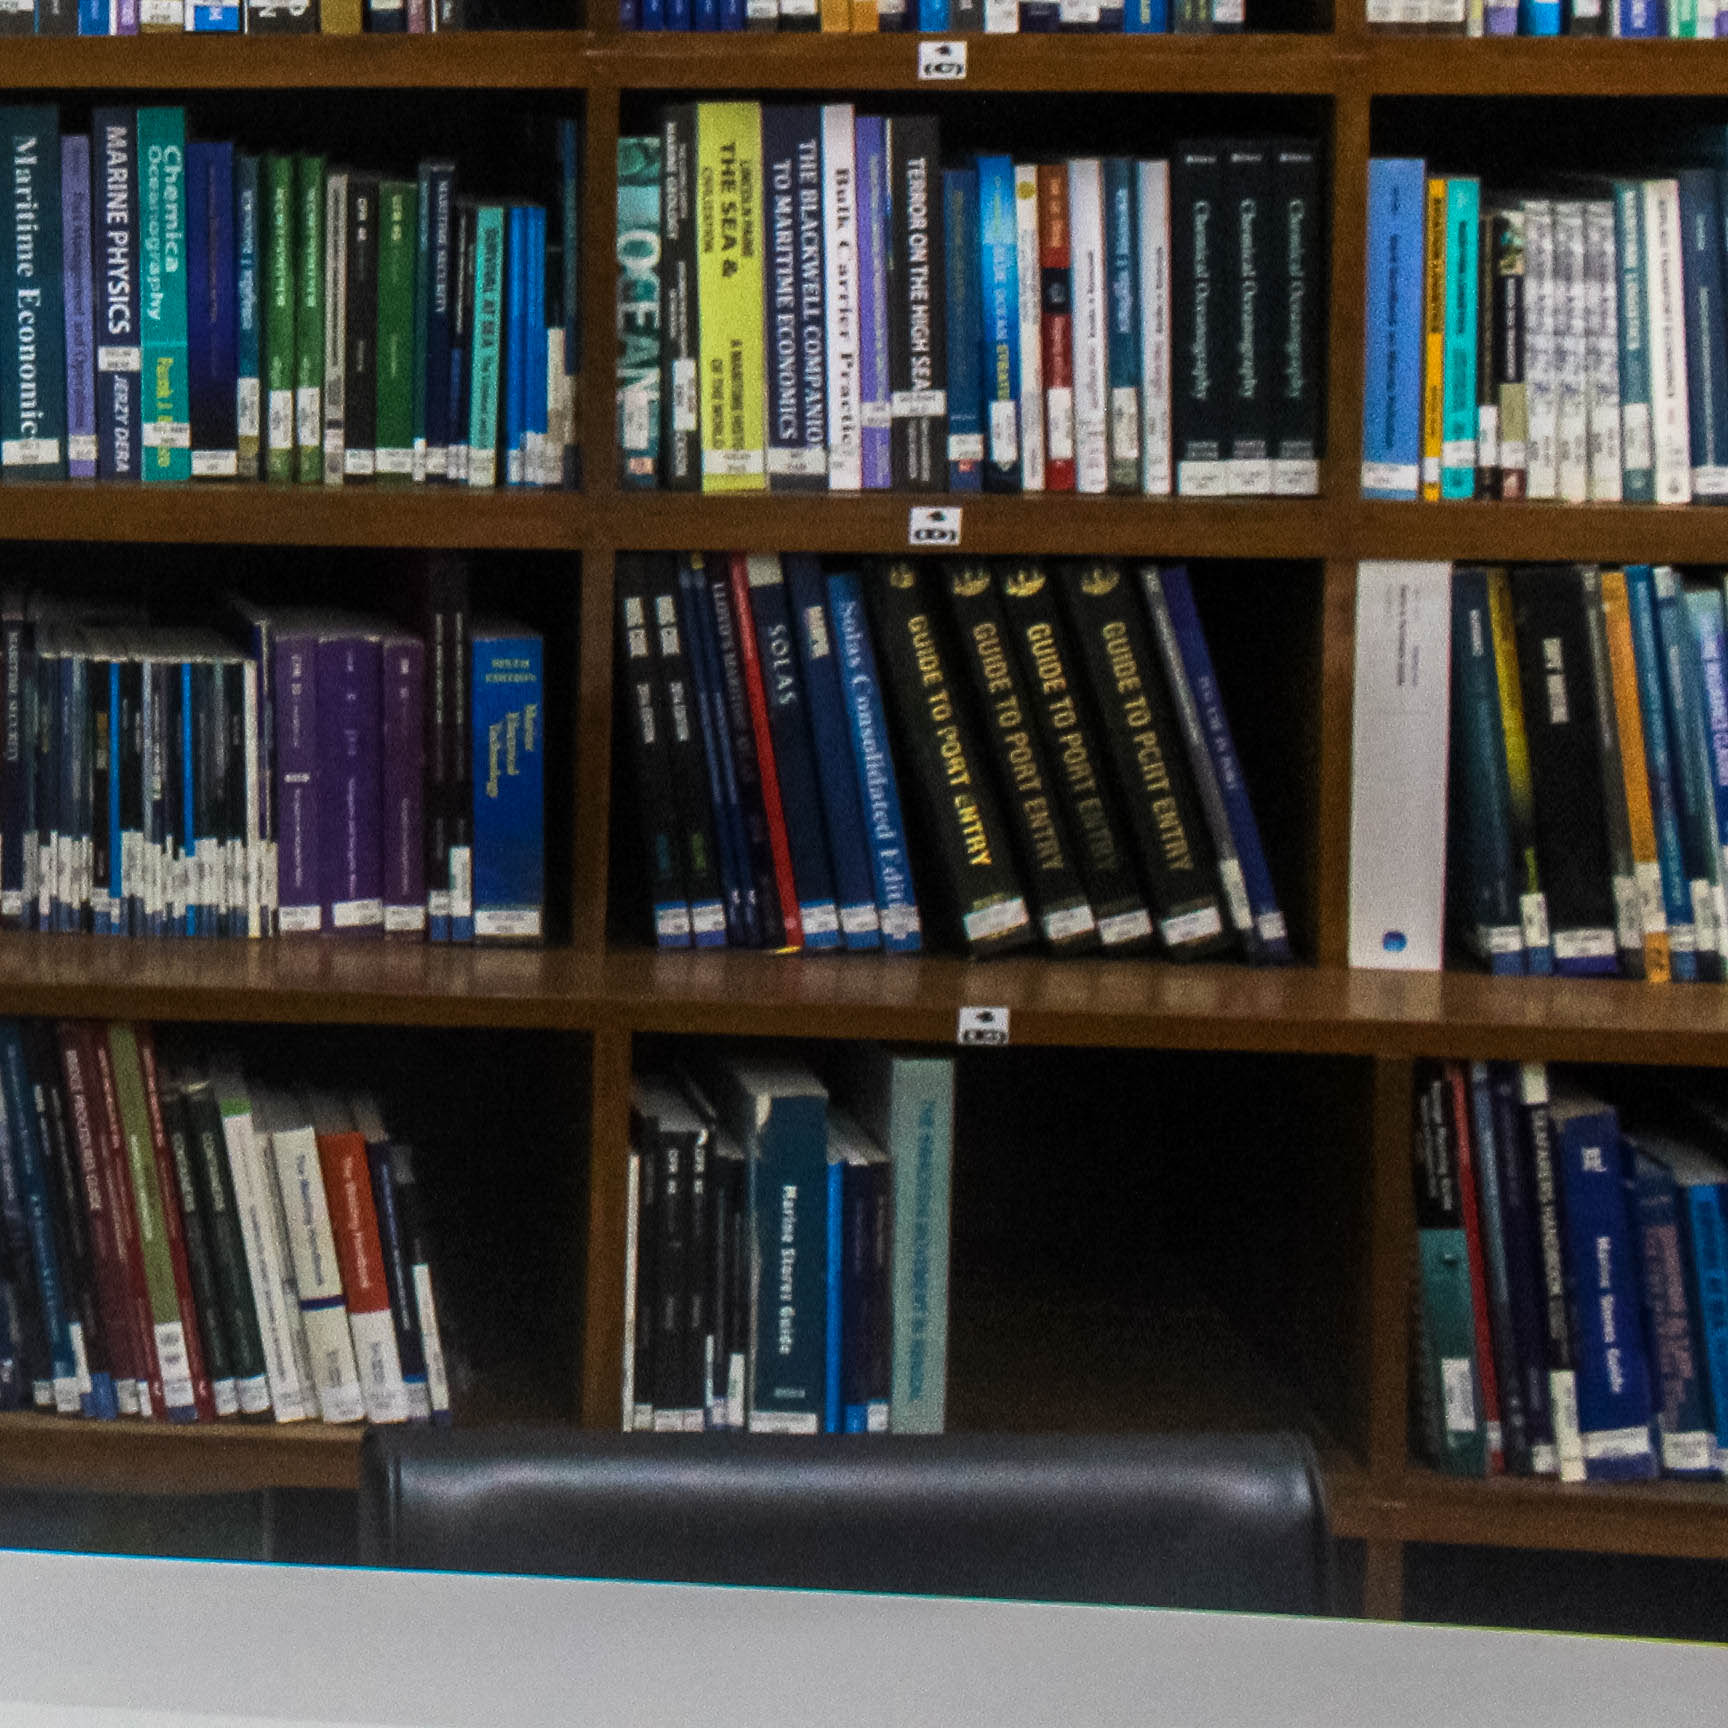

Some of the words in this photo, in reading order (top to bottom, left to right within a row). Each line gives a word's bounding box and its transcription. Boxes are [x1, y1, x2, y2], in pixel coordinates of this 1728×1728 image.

[106, 126, 129, 224] MARINE
[721, 143, 737, 195] THE
[773, 159, 793, 190] TO
[799, 139, 818, 183] THE
[907, 158, 929, 228] TERROR
[13, 135, 41, 277] Maritime
[146, 145, 165, 321] Oceanography
[721, 202, 738, 252] SEA
[107, 231, 132, 334] PHYSICS
[722, 259, 739, 278] &
[773, 195, 795, 310] MARITIME
[800, 189, 822, 321] BLACKWELL
[908, 266, 929, 300] THE
[909, 234, 928, 262] ON
[910, 305, 931, 351] HIGH
[16, 288, 45, 442] Economic
[777, 314, 798, 440] ECONOMICS
[802, 327, 824, 448] COMPANIO
[839, 351, 855, 445] Practic
[766, 623, 798, 705] SOLAS
[908, 615, 943, 686] GUIDE
[972, 623, 1009, 694] GUIDE
[1026, 623, 1067, 695] GUIDE
[1102, 621, 1135, 694] GUIDE
[927, 690, 955, 721] TO
[993, 696, 1023, 728] TO
[1048, 698, 1078, 729] TO
[1122, 697, 1148, 728] TO
[852, 675, 896, 840] Consolidated
[937, 726, 972, 785] PORT
[1004, 732, 1043, 792] PORT
[1059, 734, 1097, 792] PORT
[1132, 731, 1170, 792] PORT
[952, 795, 994, 866] ENTRY
[1023, 799, 1065, 870] ENTRY
[1077, 799, 1119, 870] ENTRY
[1151, 799, 1194, 871] ENTRY
[780, 1184, 799, 1244] Marine
[778, 1306, 798, 1356] Guide
